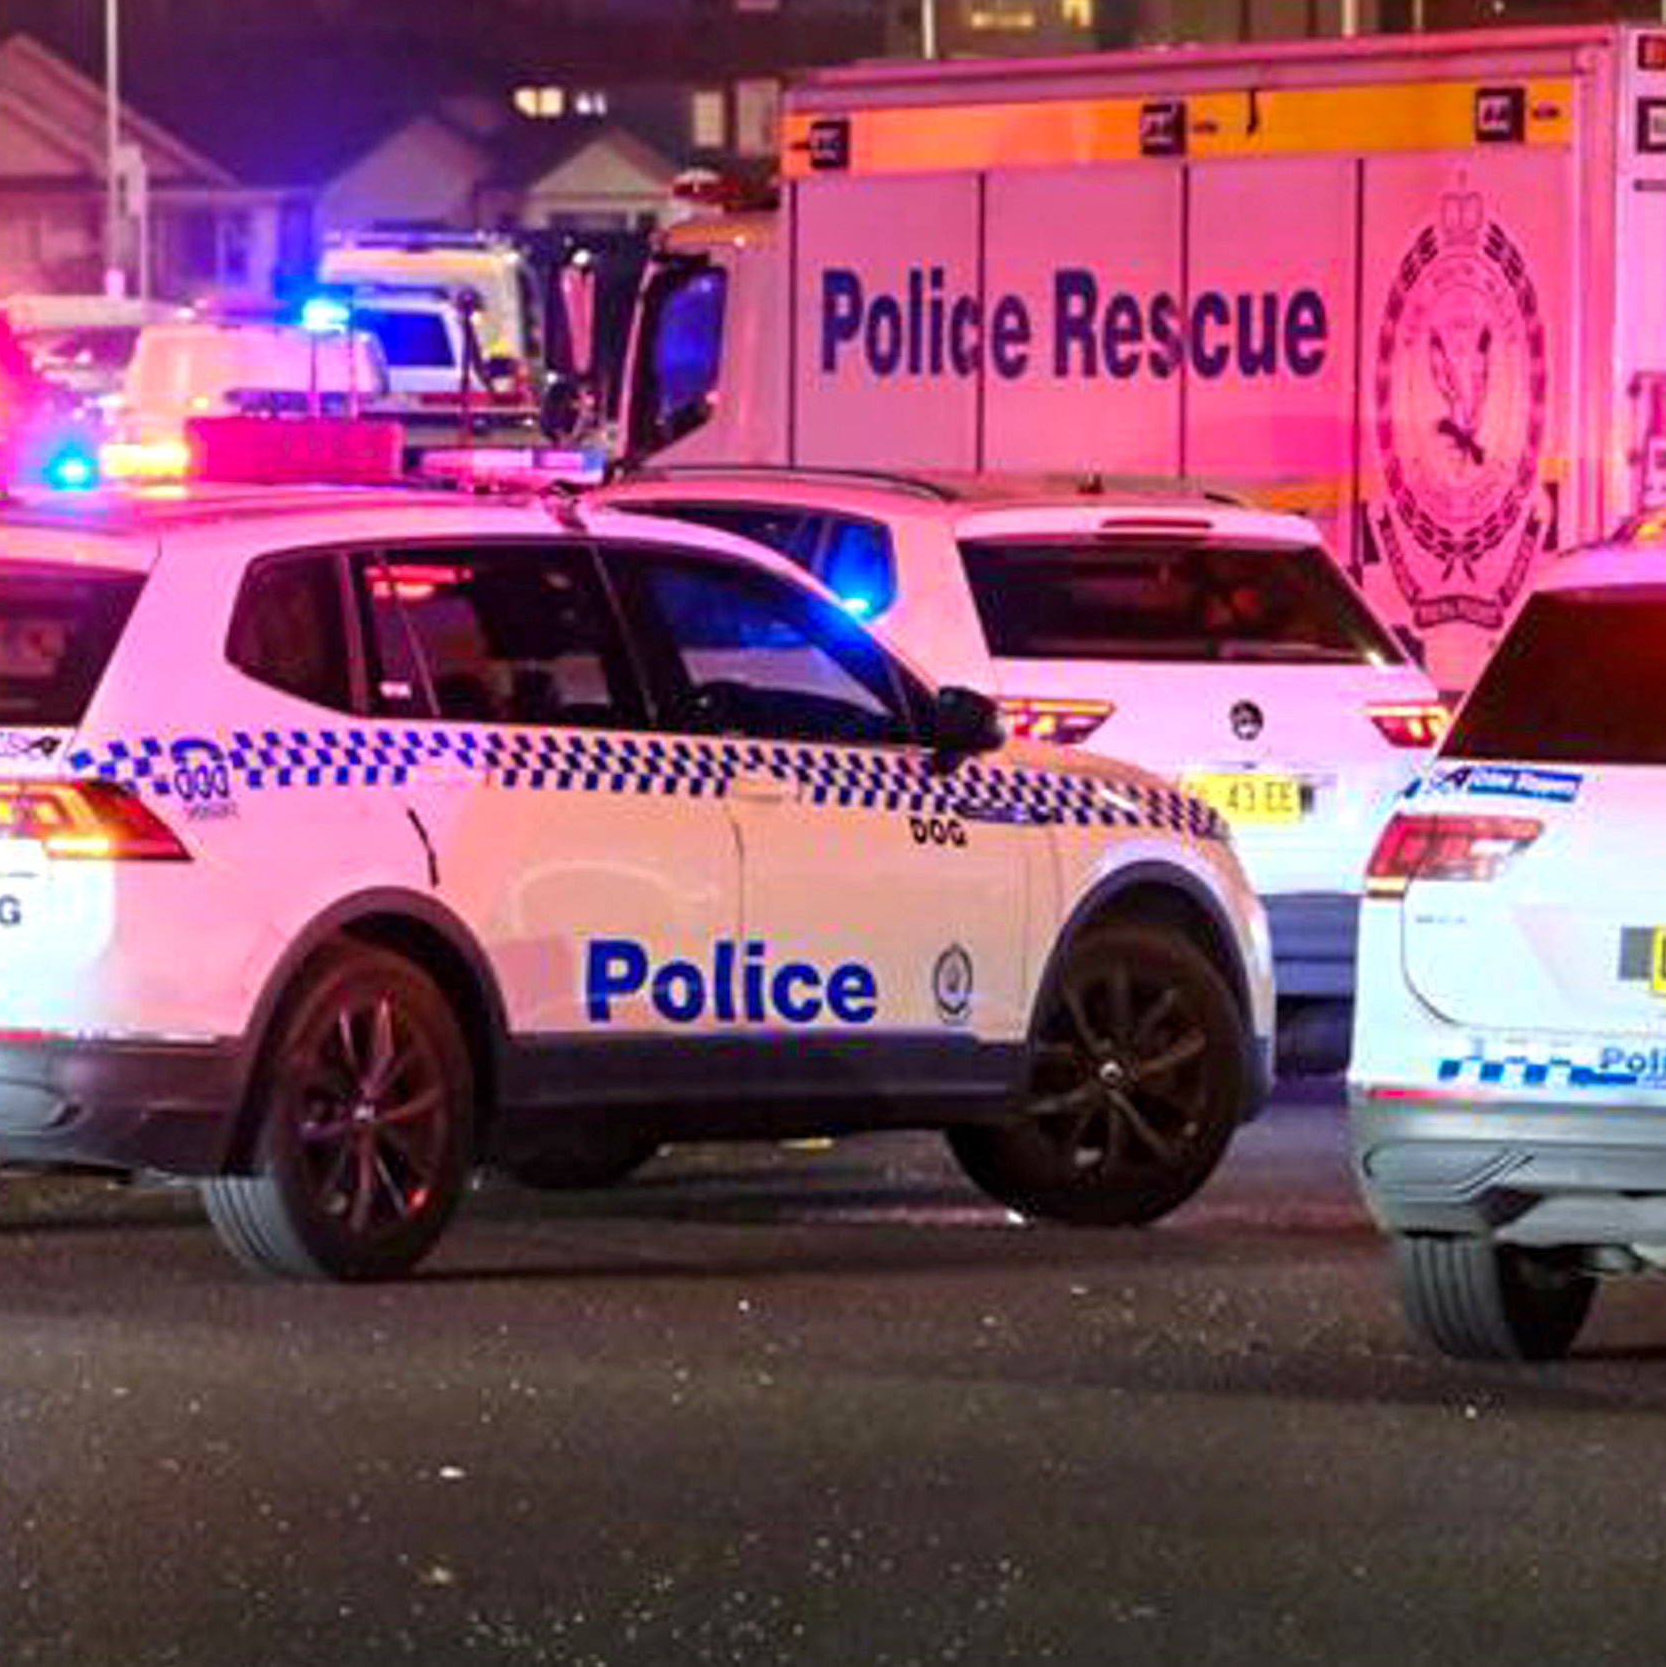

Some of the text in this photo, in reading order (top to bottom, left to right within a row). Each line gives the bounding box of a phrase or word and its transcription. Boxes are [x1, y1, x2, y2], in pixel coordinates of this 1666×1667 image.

[821, 267, 1328, 379] Police Rescue
[908, 816, 968, 846] DOG
[586, 939, 878, 1024] Police
